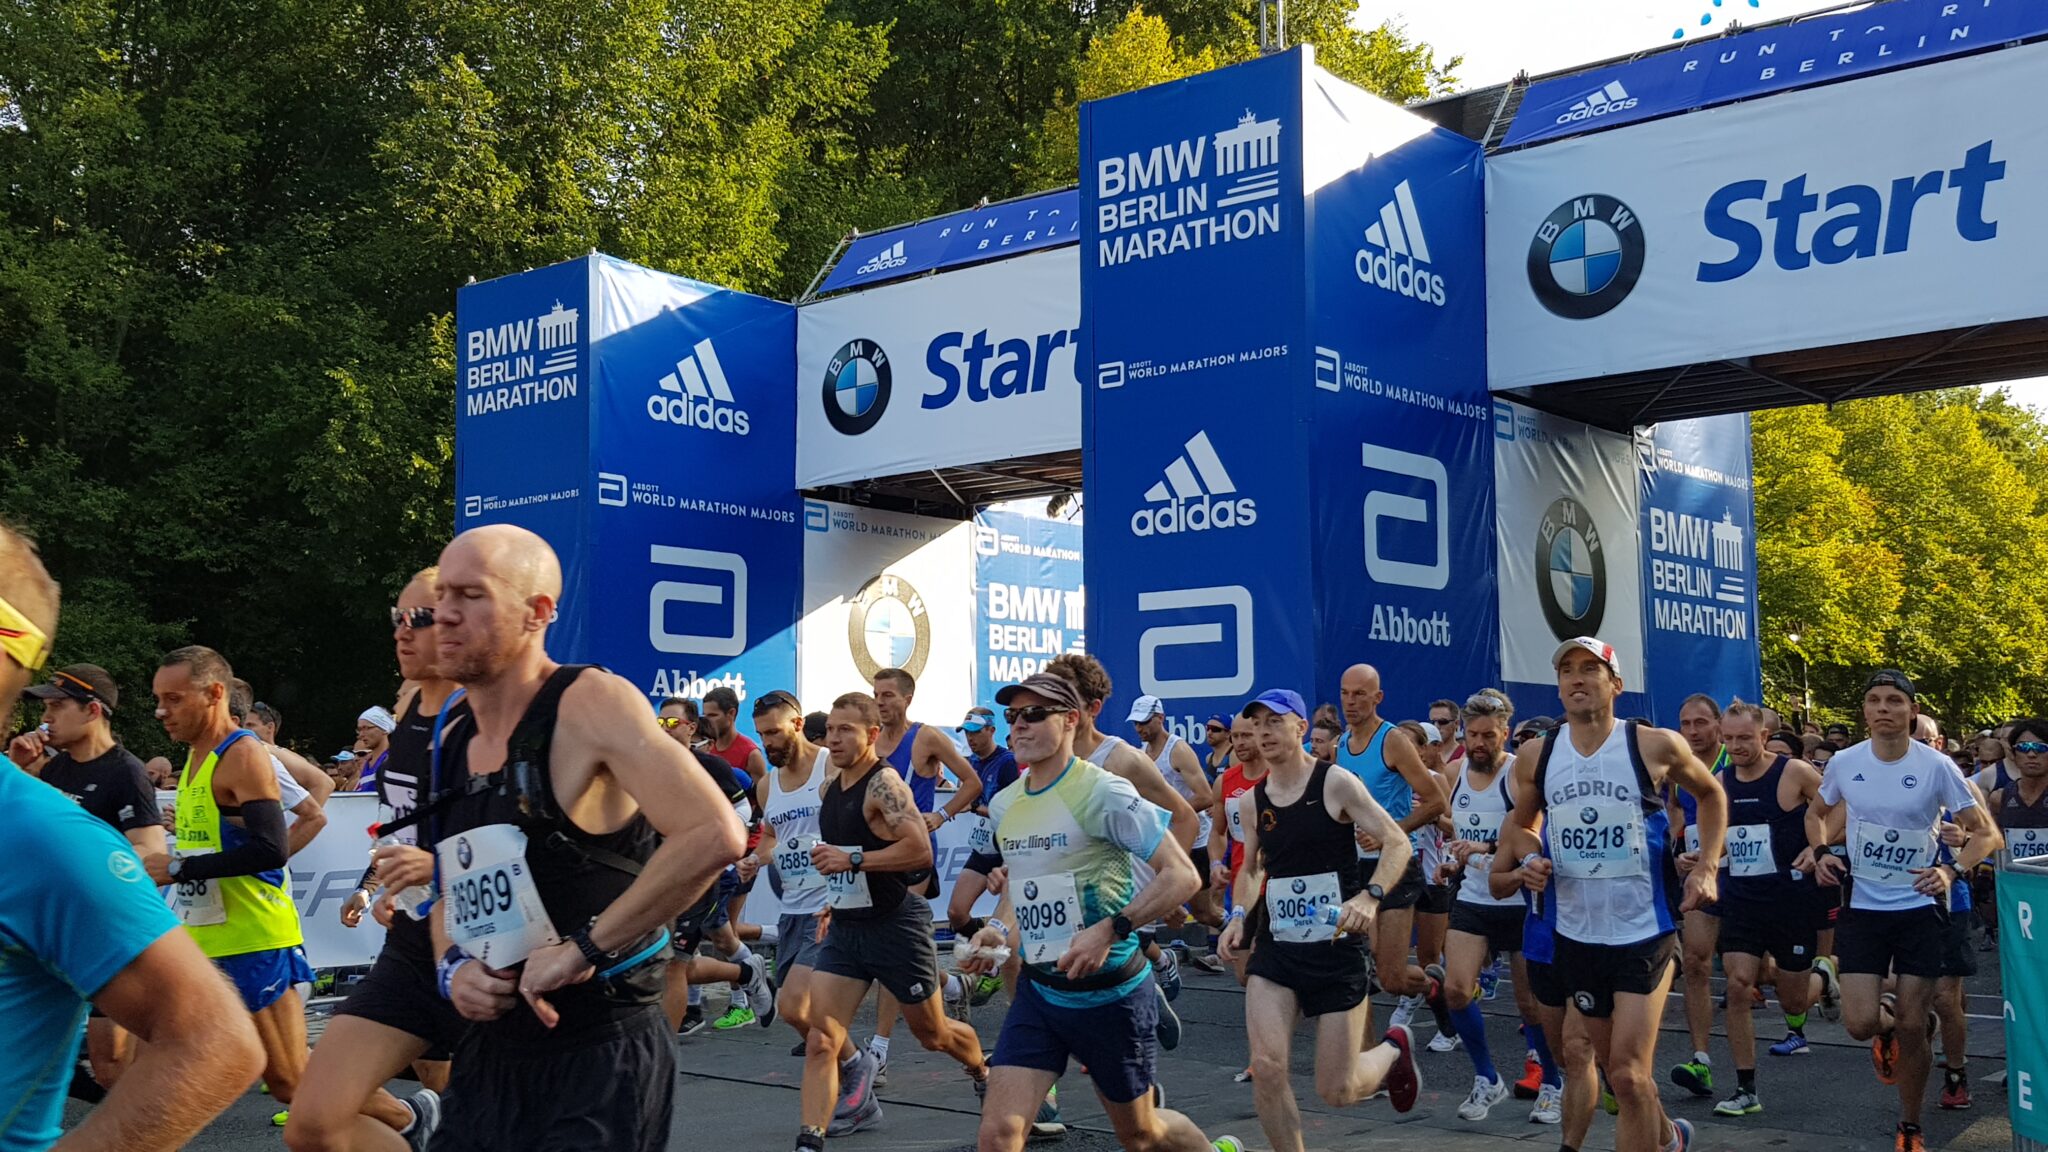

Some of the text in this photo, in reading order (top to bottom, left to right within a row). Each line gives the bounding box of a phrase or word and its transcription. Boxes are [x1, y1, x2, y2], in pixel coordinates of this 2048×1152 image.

[1683, 43, 1776, 73] RUN
[1760, 25, 1970, 80] BERLIN
[1556, 97, 1638, 125] adidas
[1098, 136, 1207, 199] BMW
[1098, 183, 1208, 233] BERLIN
[1538, 198, 1634, 245] BMW
[1697, 139, 2007, 282] Start
[939, 217, 998, 239] RUN
[977, 220, 1079, 250] BERLI
[1099, 203, 1280, 268] MARATHON
[857, 256, 907, 275] adidas
[1355, 247, 1446, 306] adidas
[467, 319, 534, 362] BMW
[467, 355, 534, 390] BERLIN
[830, 341, 886, 376] BMW
[1128, 345, 1288, 380] WORLD MARATHON MAJORS
[1344, 362, 1368, 375] ABBOTT
[467, 374, 577, 416] MARATHON
[1344, 372, 1488, 421] WORLD MARATHON MAJORS
[647, 395, 750, 436] adidas
[632, 482, 659, 492] ABBOTT
[1657, 457, 1683, 475] WORLD
[1685, 463, 1723, 485] MARATHON
[483, 488, 579, 511] WORLD MARATHON MAJORS
[632, 491, 795, 523] WORLD MARATHON MAJORS
[1131, 494, 1257, 536] adidas
[833, 518, 868, 533] WORLD
[871, 526, 926, 541] MARATHON
[1541, 501, 1600, 553] BMW
[1651, 508, 1709, 560] BMW
[1001, 541, 1080, 562] WORLD MARATHON
[1653, 560, 1712, 599] BERLIN
[988, 582, 1061, 624] BMW
[1655, 598, 1747, 640] MARATHON
[989, 623, 1062, 655] BERLIN
[1368, 604, 1451, 647] Abbott
[650, 668, 746, 701] Abbott
[989, 655, 1052, 683] MARA
[1552, 780, 1630, 805] CEDRIC
[1561, 826, 1625, 851] 66218
[1580, 851, 1606, 860] Cedric
[1864, 842, 1918, 865] 64197
[779, 851, 815, 870] 2585
[1030, 931, 1045, 940] Paul
